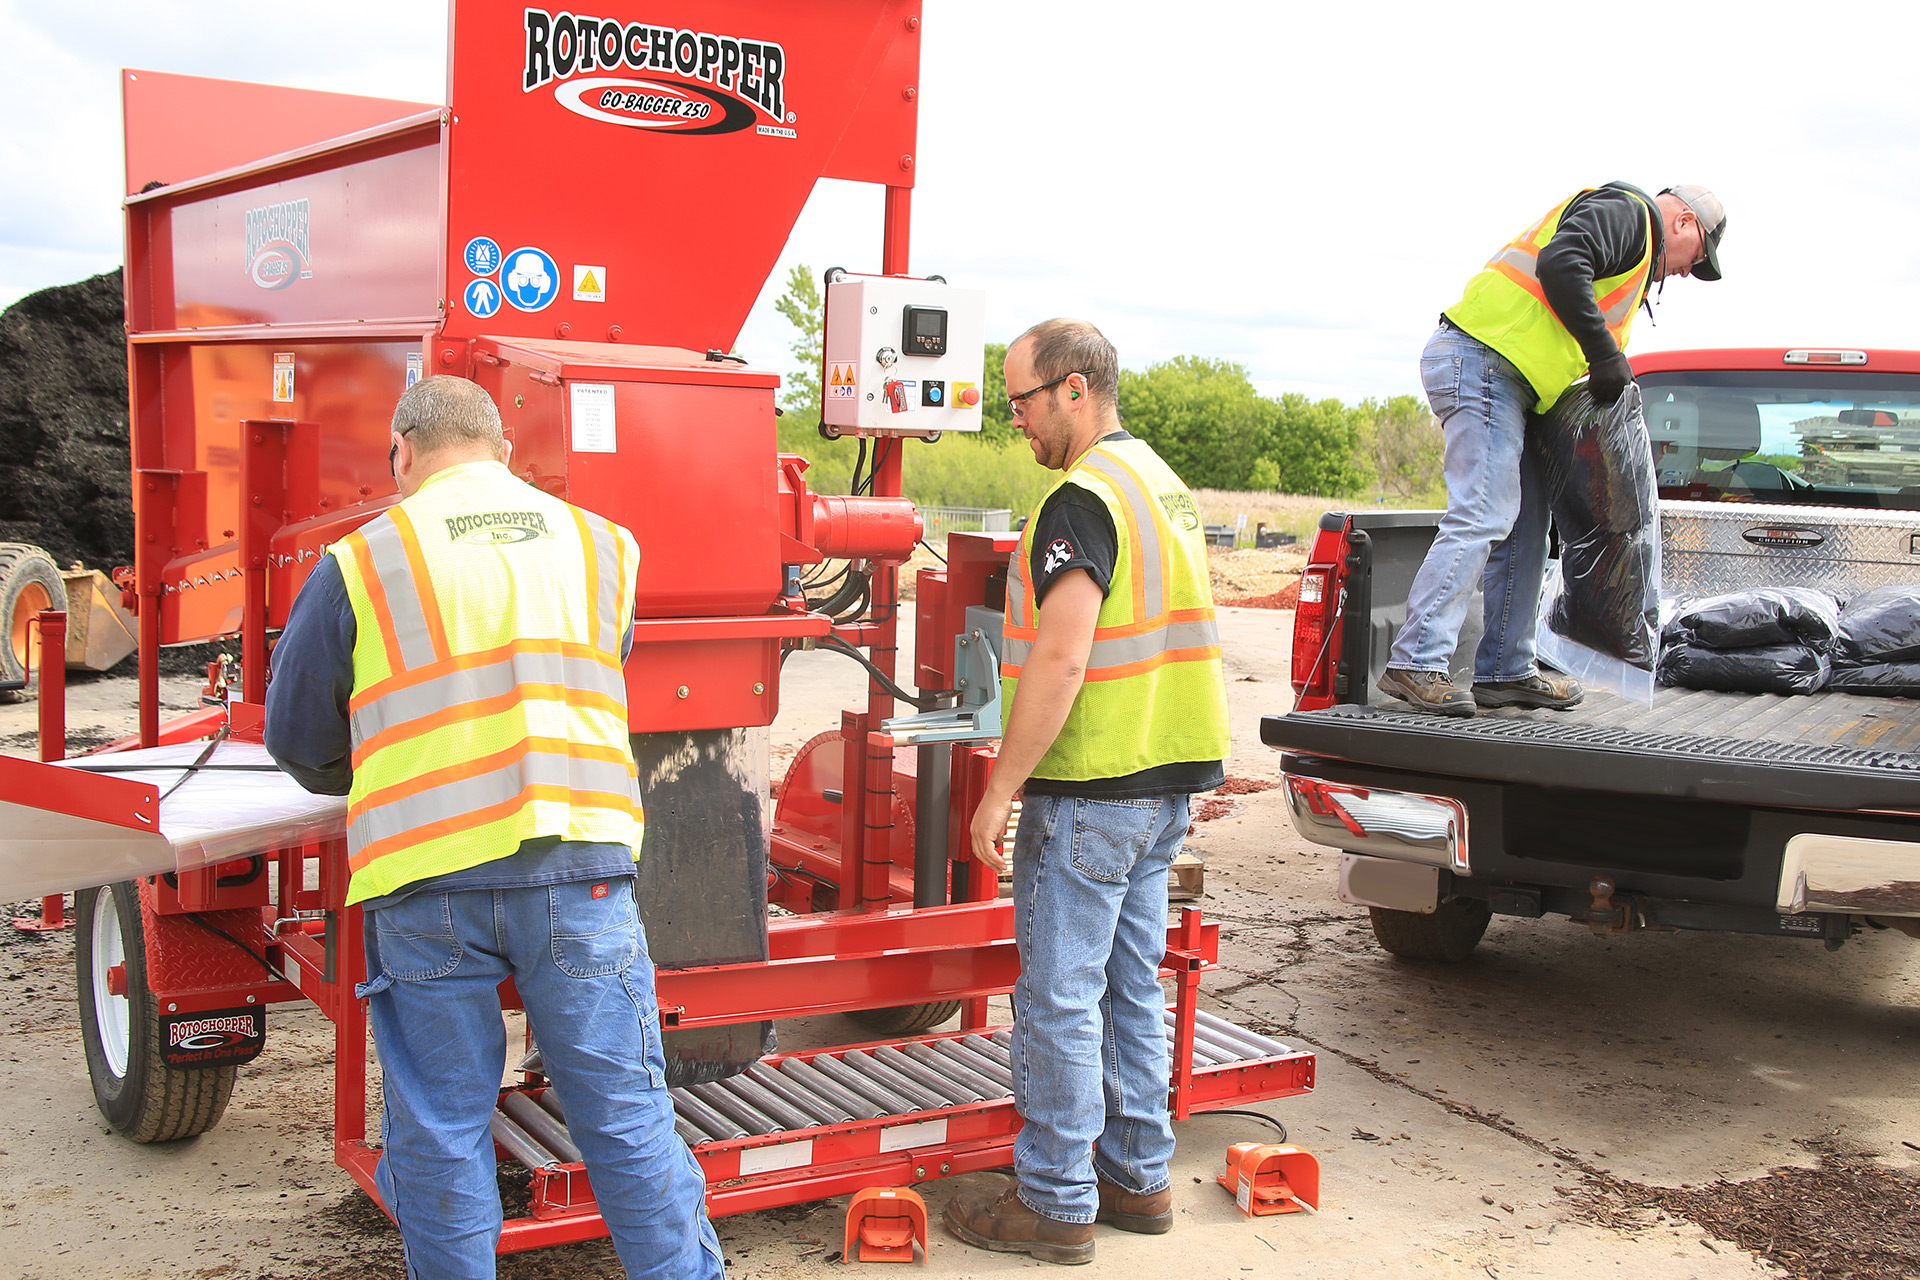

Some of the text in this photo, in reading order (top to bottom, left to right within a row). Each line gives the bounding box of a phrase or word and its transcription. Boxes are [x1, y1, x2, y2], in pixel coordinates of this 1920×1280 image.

[525, 10, 784, 122] ROTOCHOPPER
[600, 90, 710, 120] GO-BAGGER 250
[245, 198, 309, 274] ROTOCHOPPER
[445, 511, 548, 541] ROTOCHOPPER
[491, 531, 512, 540] Inc.
[1758, 537, 1809, 545] CHAMPION
[1766, 529, 1798, 539] DELTA
[170, 1015, 254, 1046] ROTOCHOPPER
[204, 1050, 212, 1060] In
[214, 1048, 232, 1058] One
